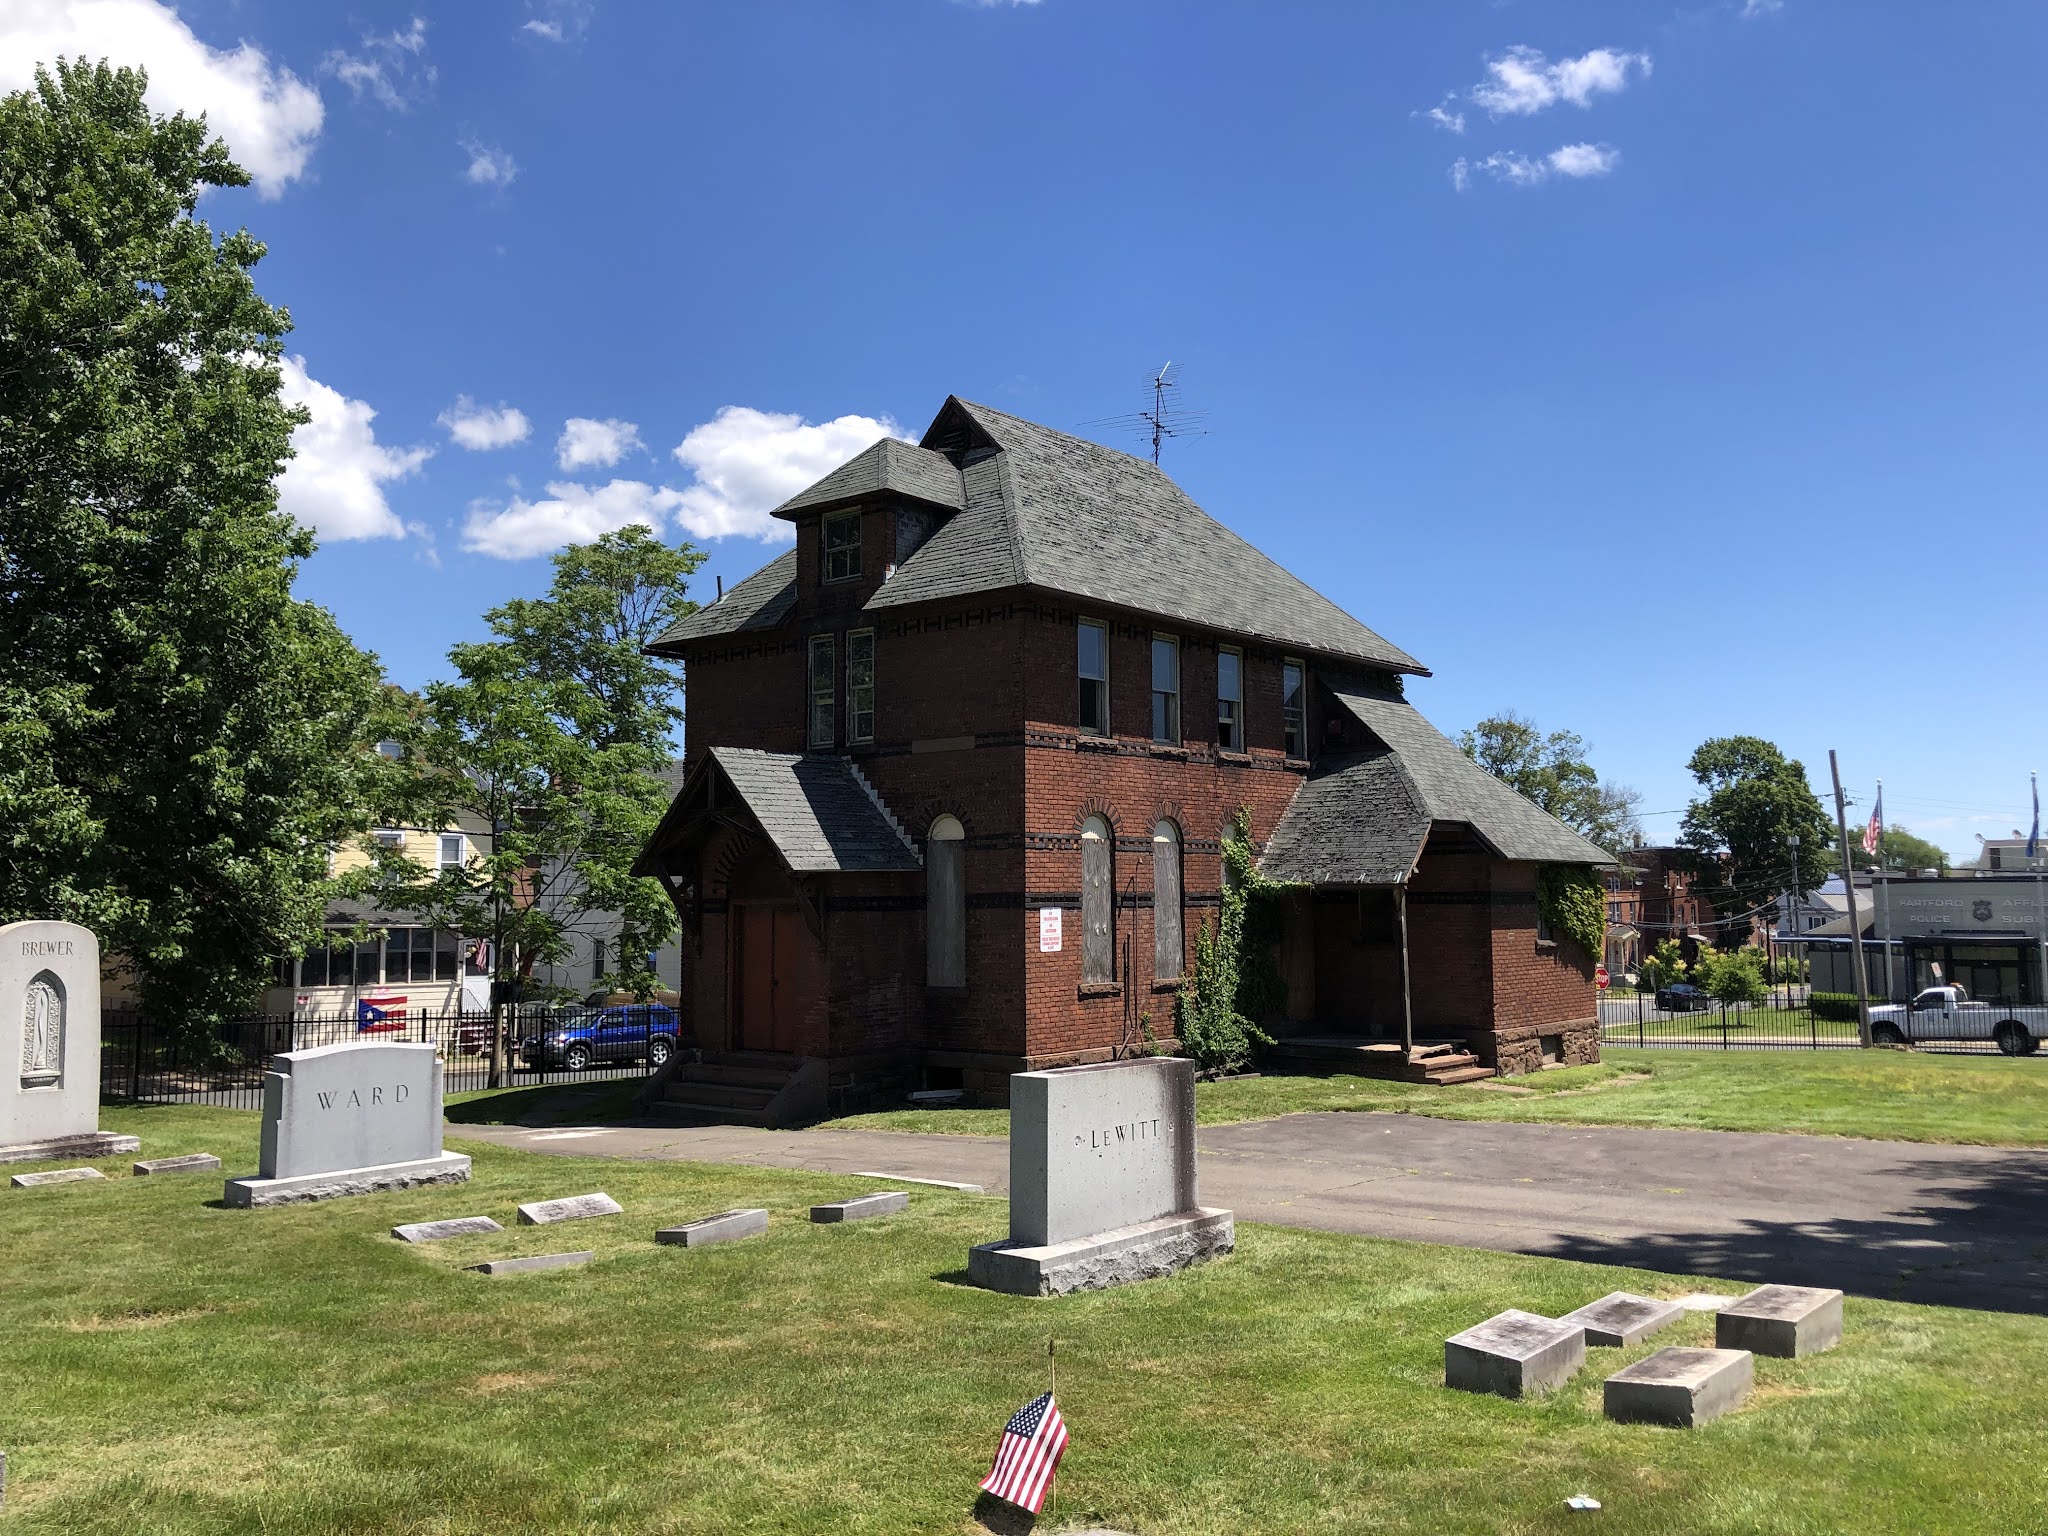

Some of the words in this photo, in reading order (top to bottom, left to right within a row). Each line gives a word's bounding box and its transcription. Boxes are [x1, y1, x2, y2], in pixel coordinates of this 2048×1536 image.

[1900, 899, 1964, 907] HARTFORD
[1910, 915, 1951, 923] POLICE
[22, 940, 73, 956] BREWER
[1595, 973, 1608, 983] STOP
[317, 1084, 409, 1110] WARD
